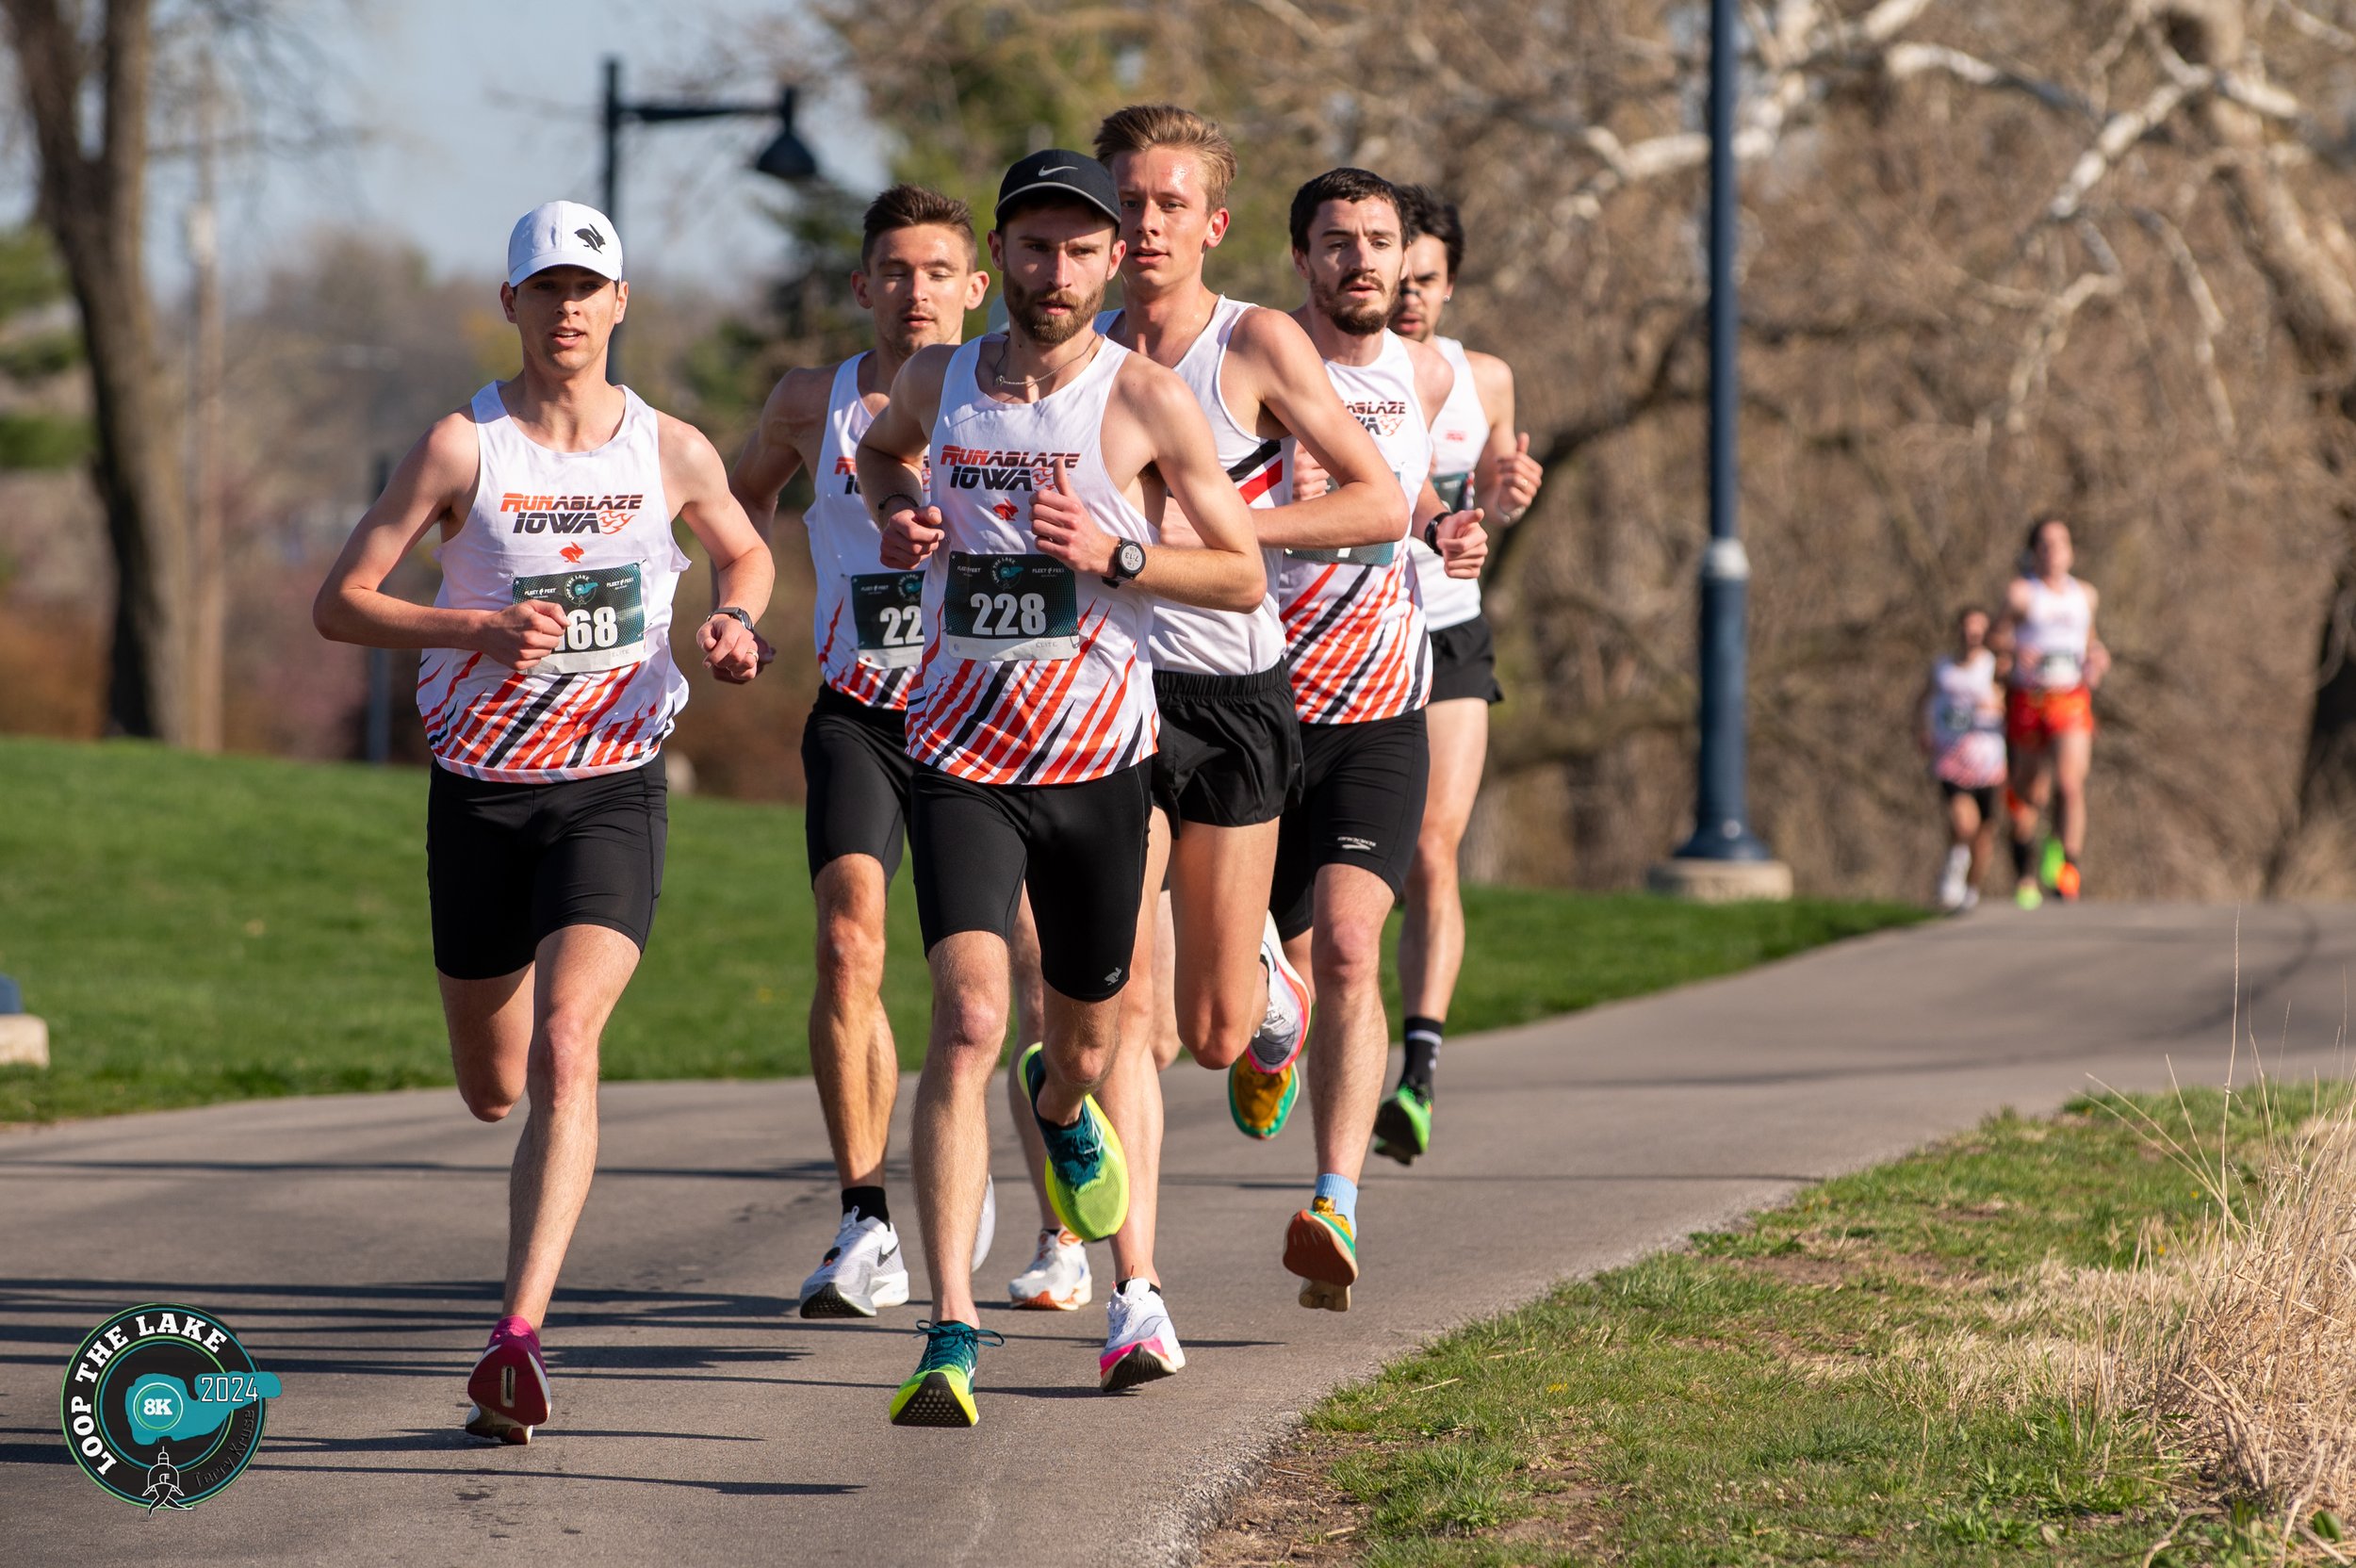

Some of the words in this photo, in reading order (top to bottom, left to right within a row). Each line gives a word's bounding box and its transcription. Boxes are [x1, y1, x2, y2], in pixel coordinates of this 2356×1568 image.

[950, 466, 1033, 492] IOWA
[500, 493, 644, 512] RUNABLAZE
[513, 513, 600, 534] IOWA
[879, 605, 924, 646] 22
[970, 593, 1046, 636] 228
